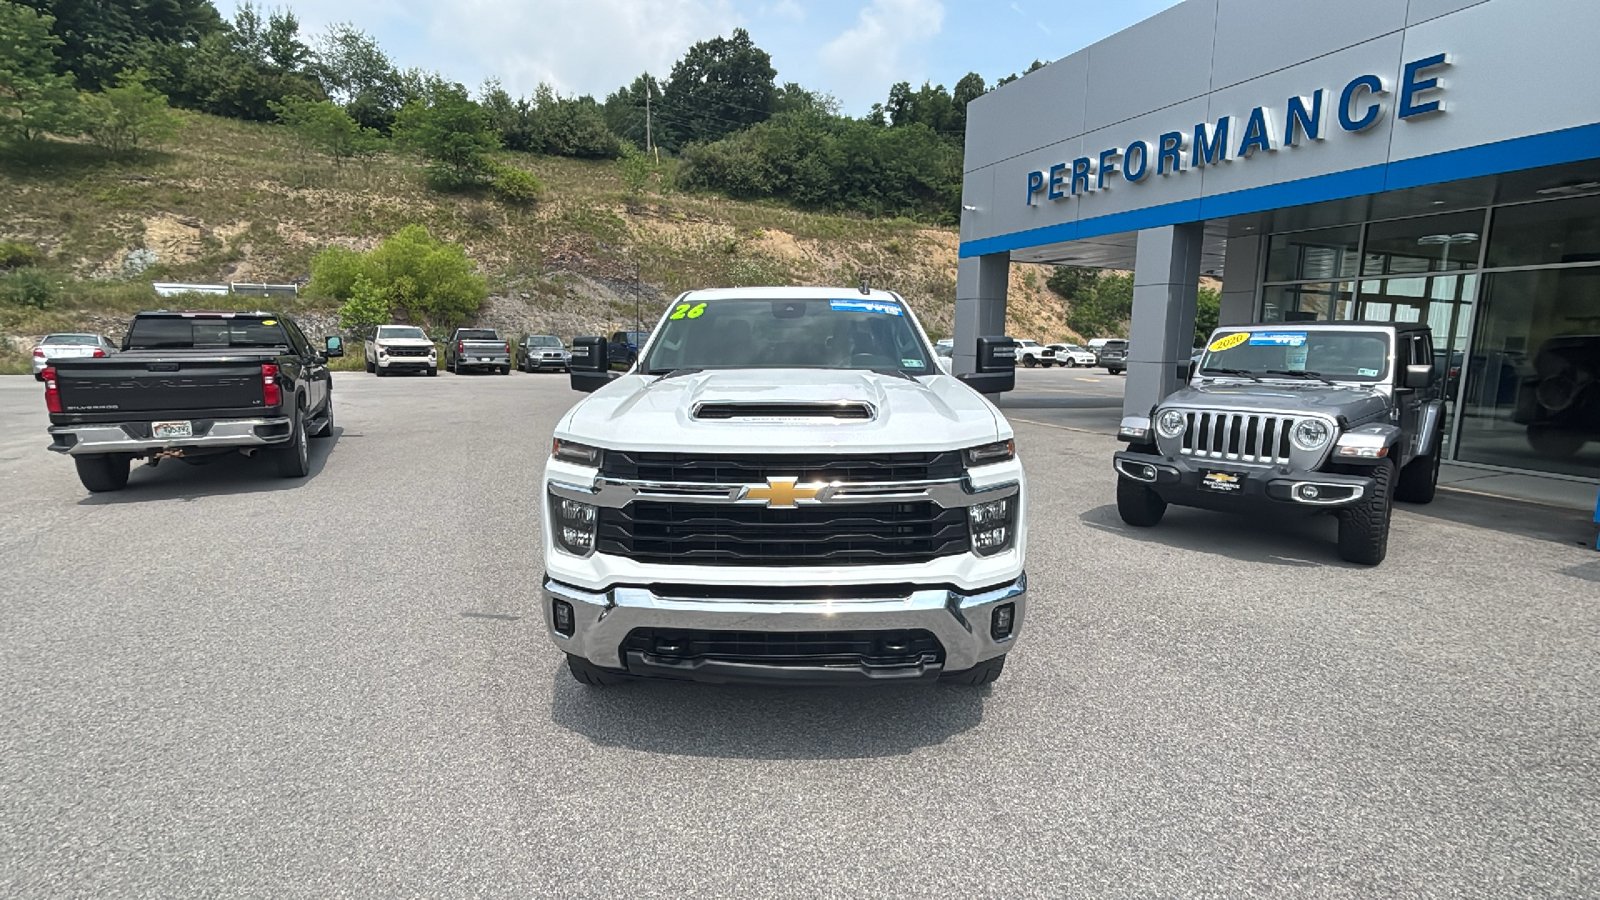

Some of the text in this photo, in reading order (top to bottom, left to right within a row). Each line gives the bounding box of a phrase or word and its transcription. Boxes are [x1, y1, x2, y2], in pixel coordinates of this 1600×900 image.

[1026, 53, 1451, 206] PERFORMANCE
[670, 303, 708, 320] 26
[1216, 334, 1244, 349] 2020
[1202, 479, 1241, 489] PERFORMANCE
